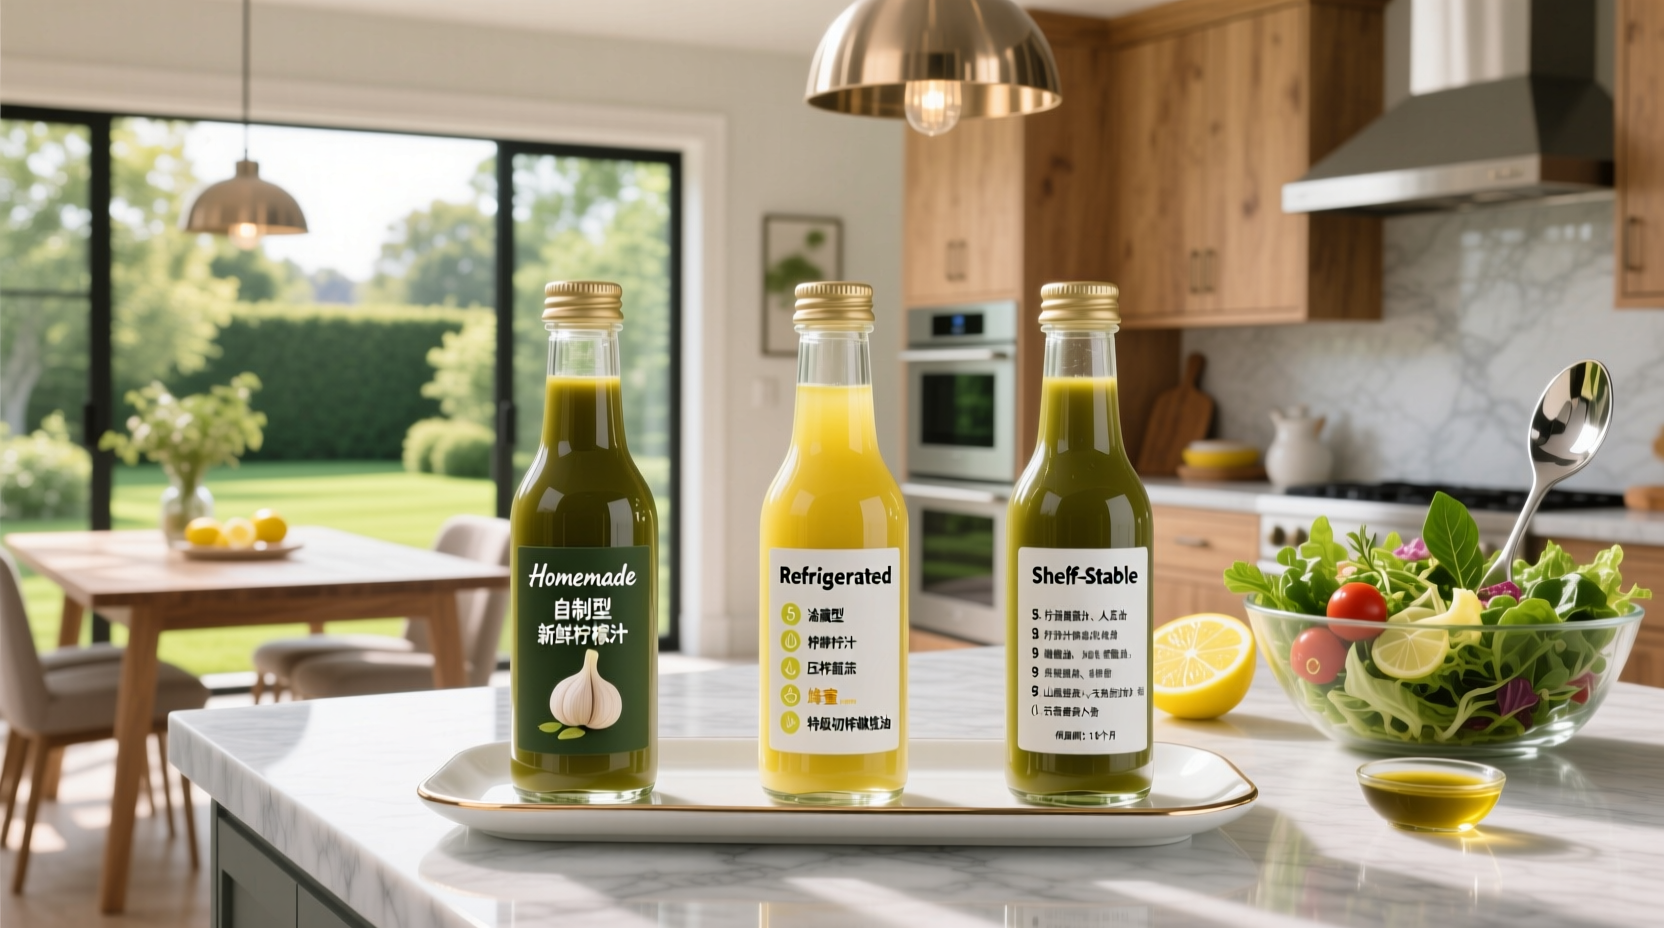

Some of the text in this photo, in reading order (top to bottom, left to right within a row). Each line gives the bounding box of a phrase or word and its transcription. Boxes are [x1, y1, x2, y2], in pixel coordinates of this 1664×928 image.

[528, 562, 637, 588] Homemade
[780, 565, 892, 591] Refrigerated
[554, 597, 612, 621] 自制型
